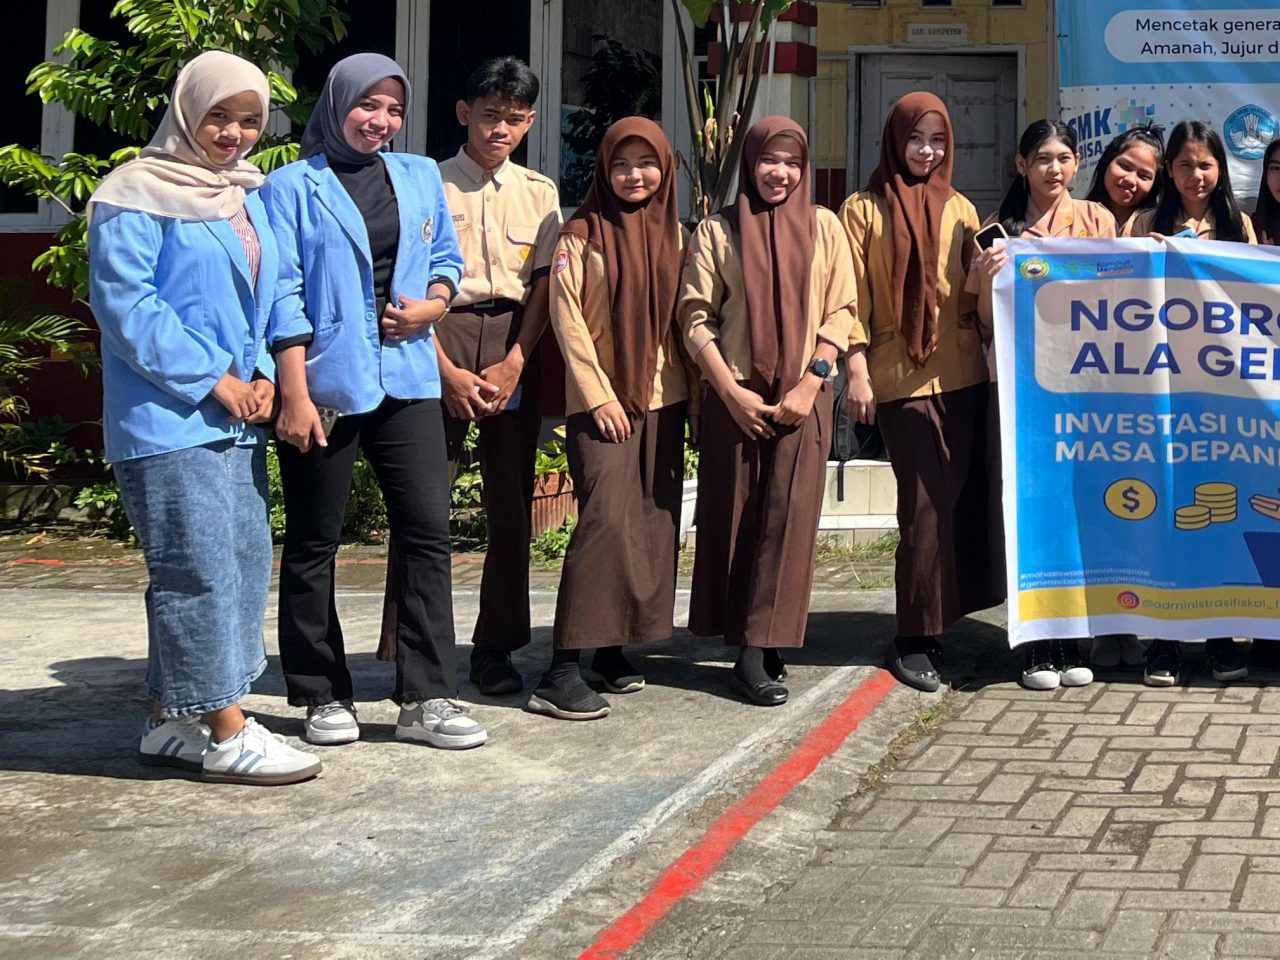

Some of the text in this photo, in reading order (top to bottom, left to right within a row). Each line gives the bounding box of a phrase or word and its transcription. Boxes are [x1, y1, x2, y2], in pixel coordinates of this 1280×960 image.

[1135, 18, 1220, 32] Mencetak
[1140, 41, 1218, 56] Amanah,
[1221, 41, 1264, 58] Jujur
[1068, 108, 1111, 142] SMK
[1069, 342, 1182, 375] ALA
[1054, 411, 1227, 435] INVESTASI
[1054, 440, 1156, 463] MASA
